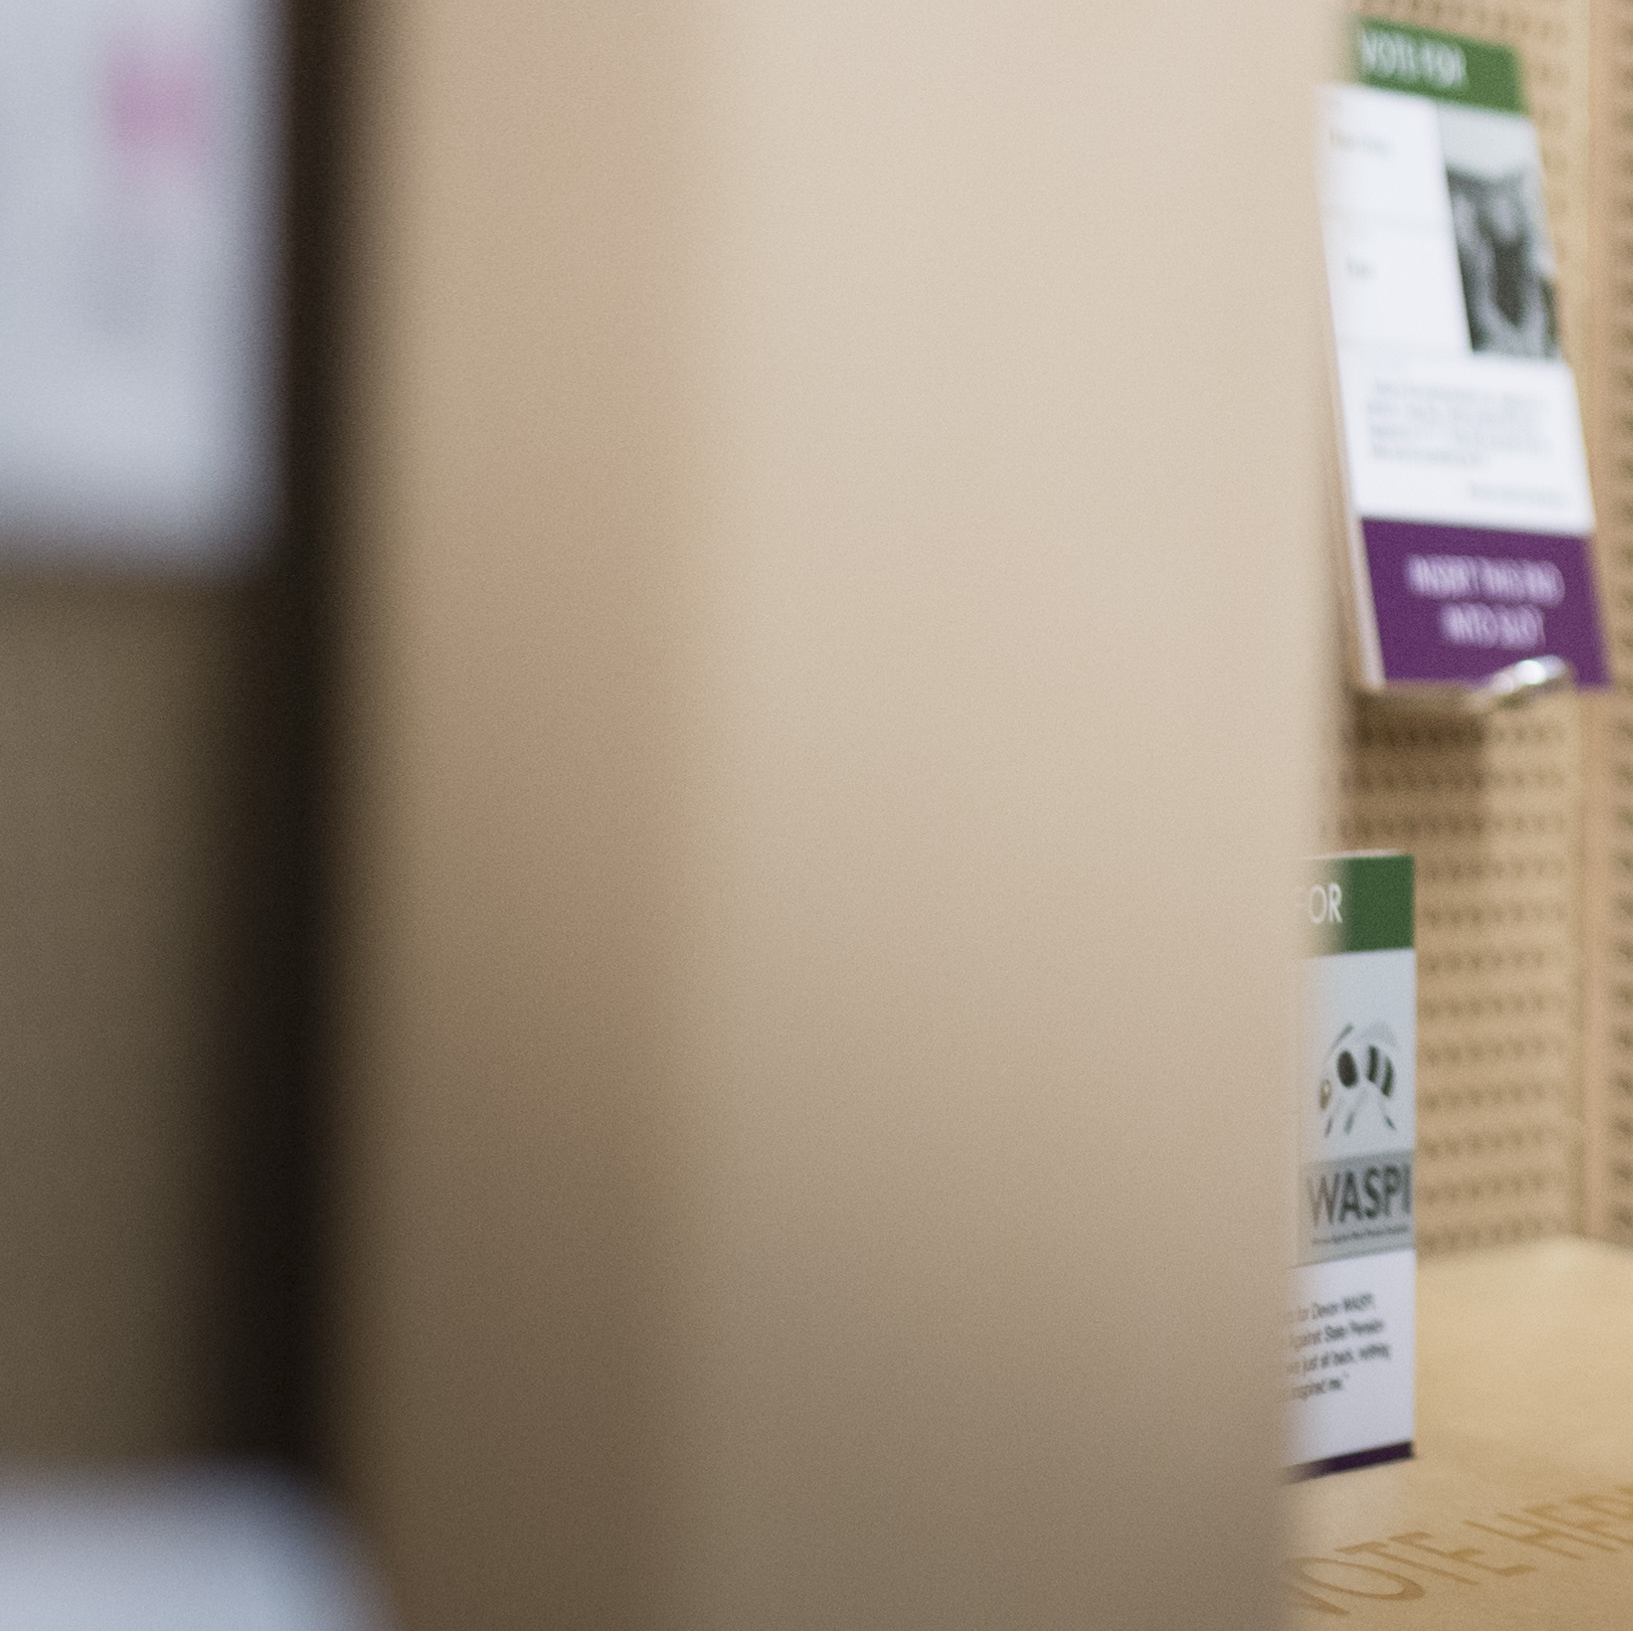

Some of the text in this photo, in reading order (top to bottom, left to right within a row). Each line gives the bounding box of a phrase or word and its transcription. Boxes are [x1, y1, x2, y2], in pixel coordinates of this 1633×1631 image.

[1360, 30, 1468, 91] VOTE FOR
[1404, 555, 1478, 601] INSERT
[1304, 1163, 1411, 1227] WASPI
